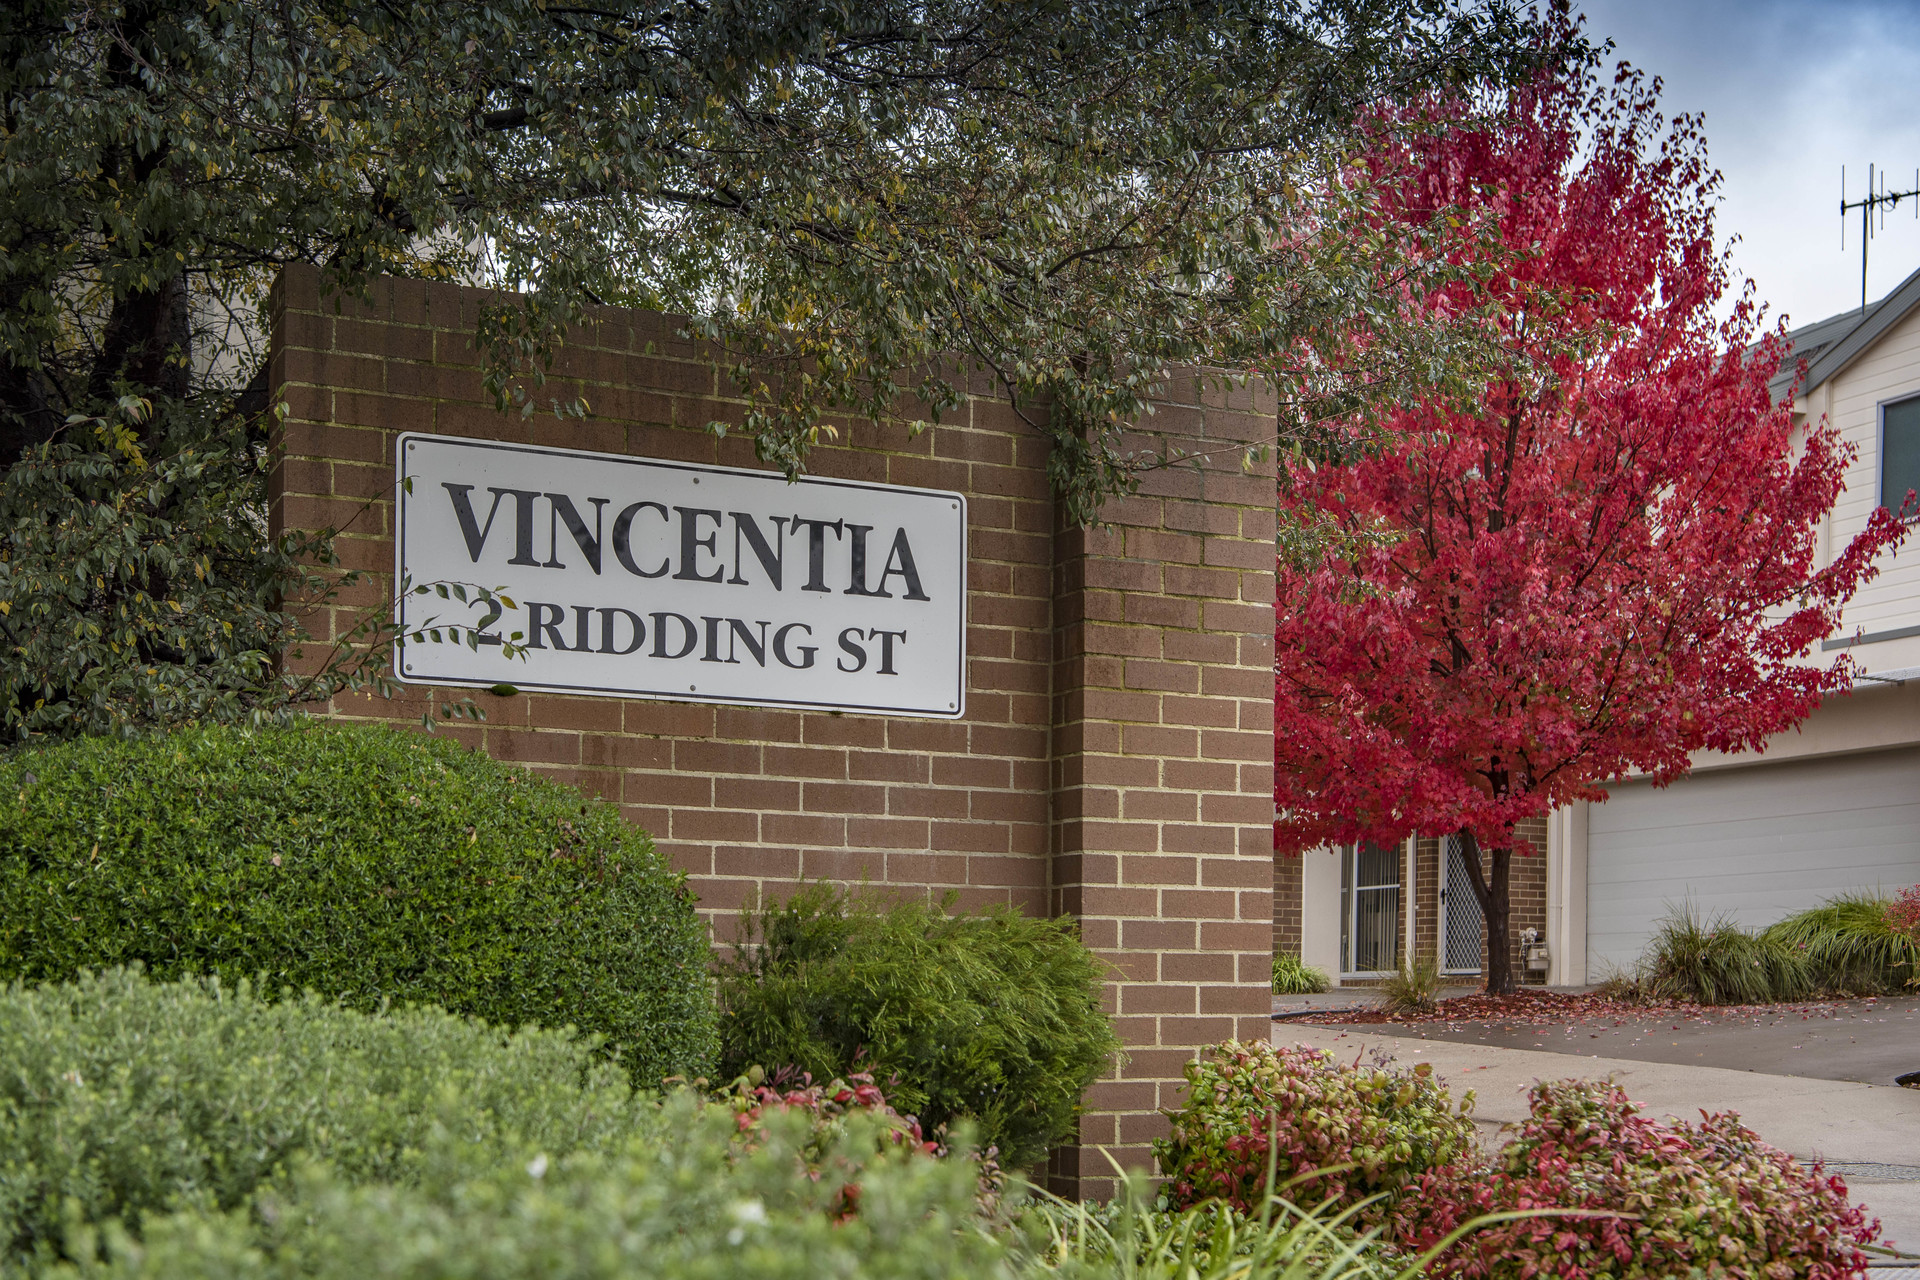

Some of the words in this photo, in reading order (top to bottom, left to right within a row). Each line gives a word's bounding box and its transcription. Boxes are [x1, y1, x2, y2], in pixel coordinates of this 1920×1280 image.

[441, 482, 930, 601] VINCENTIA
[467, 598, 502, 646] 2
[523, 601, 819, 669] RIDDING
[836, 627, 906, 675] ST
